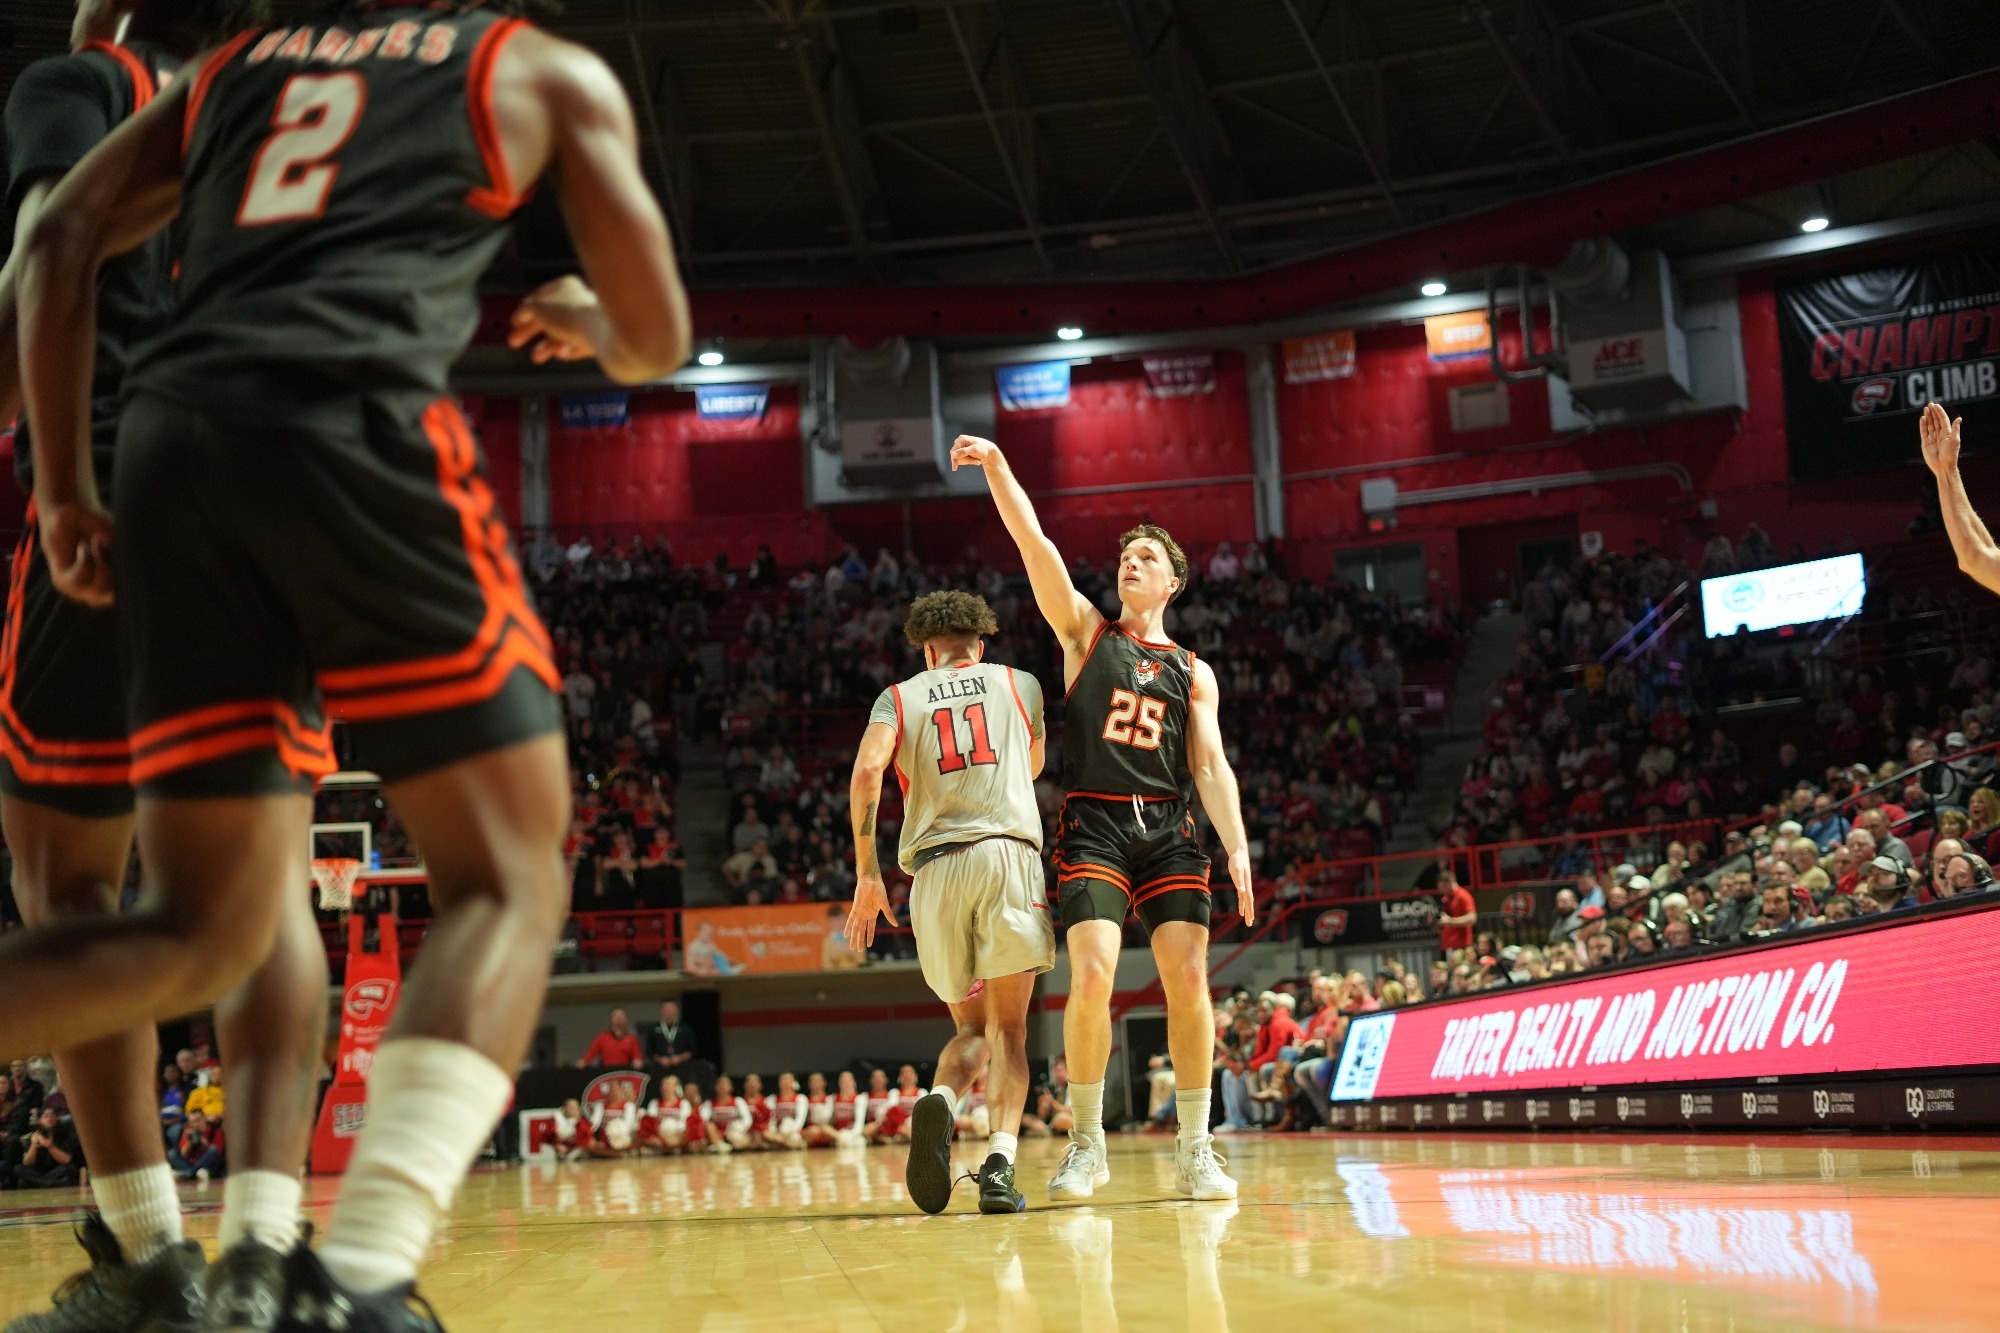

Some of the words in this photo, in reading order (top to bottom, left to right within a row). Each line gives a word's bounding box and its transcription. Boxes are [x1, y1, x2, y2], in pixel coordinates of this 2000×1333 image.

[235, 70, 367, 228] 2
[701, 394, 767, 414] LIBERTY
[1907, 361, 1997, 407] CLIMB
[927, 676, 987, 703] ALLEN
[932, 702, 998, 775] 11
[1102, 688, 1167, 750] 25
[1431, 1010, 1515, 1081] TARTER
[1502, 996, 1602, 1077] REALTY
[1586, 989, 1656, 1064] AND
[1644, 968, 1795, 1060] AUCTION
[1781, 958, 1848, 1049] CO.
[1926, 1089, 1955, 1100] SOLUTIONS
